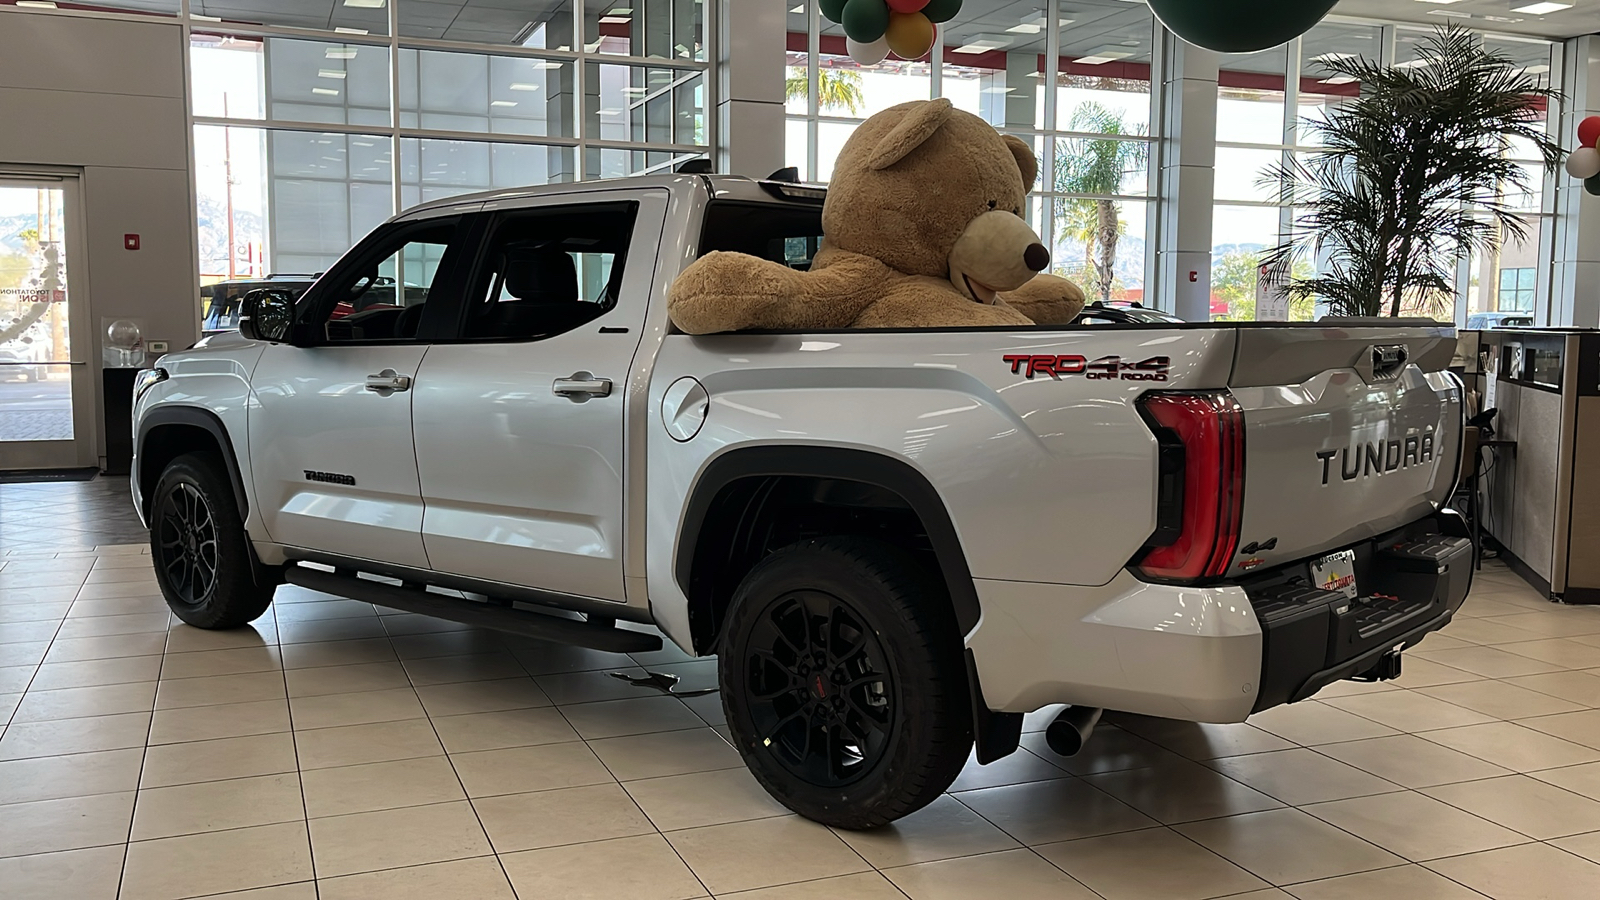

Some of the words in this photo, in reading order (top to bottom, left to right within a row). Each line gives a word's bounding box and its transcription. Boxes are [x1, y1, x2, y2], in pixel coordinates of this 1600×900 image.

[1003, 355, 1088, 381] TRD
[1086, 372, 1118, 380] OFF
[1120, 373, 1169, 382] ROAD
[1315, 432, 1434, 487] TUNDRA
[303, 469, 357, 486] TUNDRA
